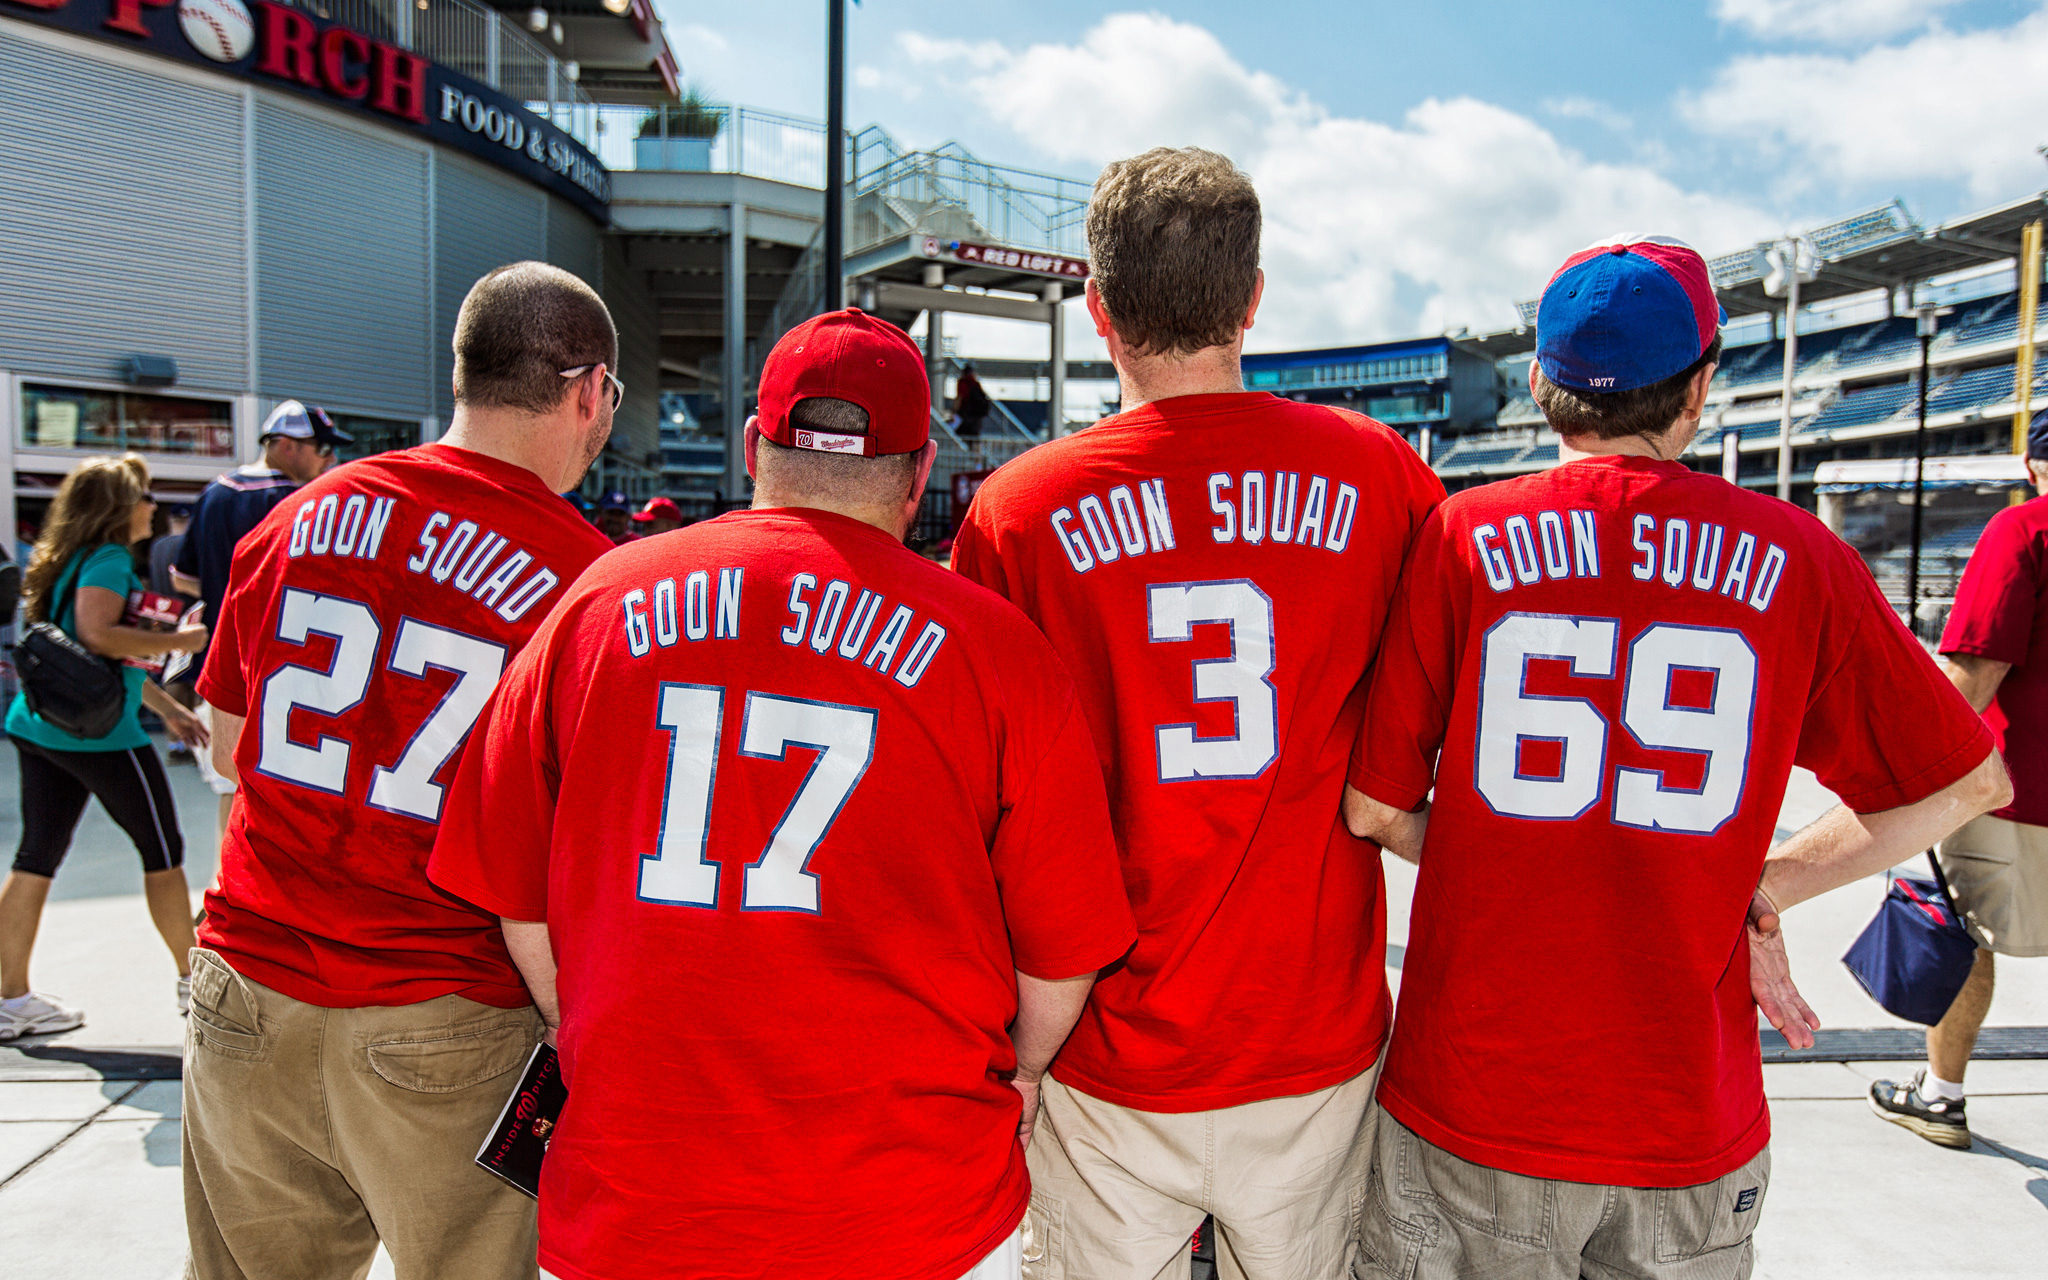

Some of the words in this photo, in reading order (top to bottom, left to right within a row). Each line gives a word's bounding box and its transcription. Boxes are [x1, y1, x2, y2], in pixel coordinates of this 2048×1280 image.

[439, 83, 525, 150] FOOD
[526, 126, 547, 164] &
[982, 248, 1020, 267] RED
[1021, 252, 1065, 274] LOFT
[1588, 377, 1616, 388] 1977
[288, 493, 397, 560] GOON
[407, 510, 560, 623] SQUAD
[1050, 477, 1177, 575] GOON
[1206, 469, 1360, 555] SQUAD
[1472, 509, 1601, 593] GOON
[1630, 512, 1788, 614] SQUAD
[623, 566, 745, 659] GOON
[780, 572, 947, 690] SQUAD
[1145, 577, 1281, 785] 3
[254, 584, 510, 825] 27
[1472, 610, 1760, 838] 69
[636, 680, 880, 917] 17
[490, 1120, 523, 1167] INSIDE
[531, 1052, 558, 1095] PITCH
